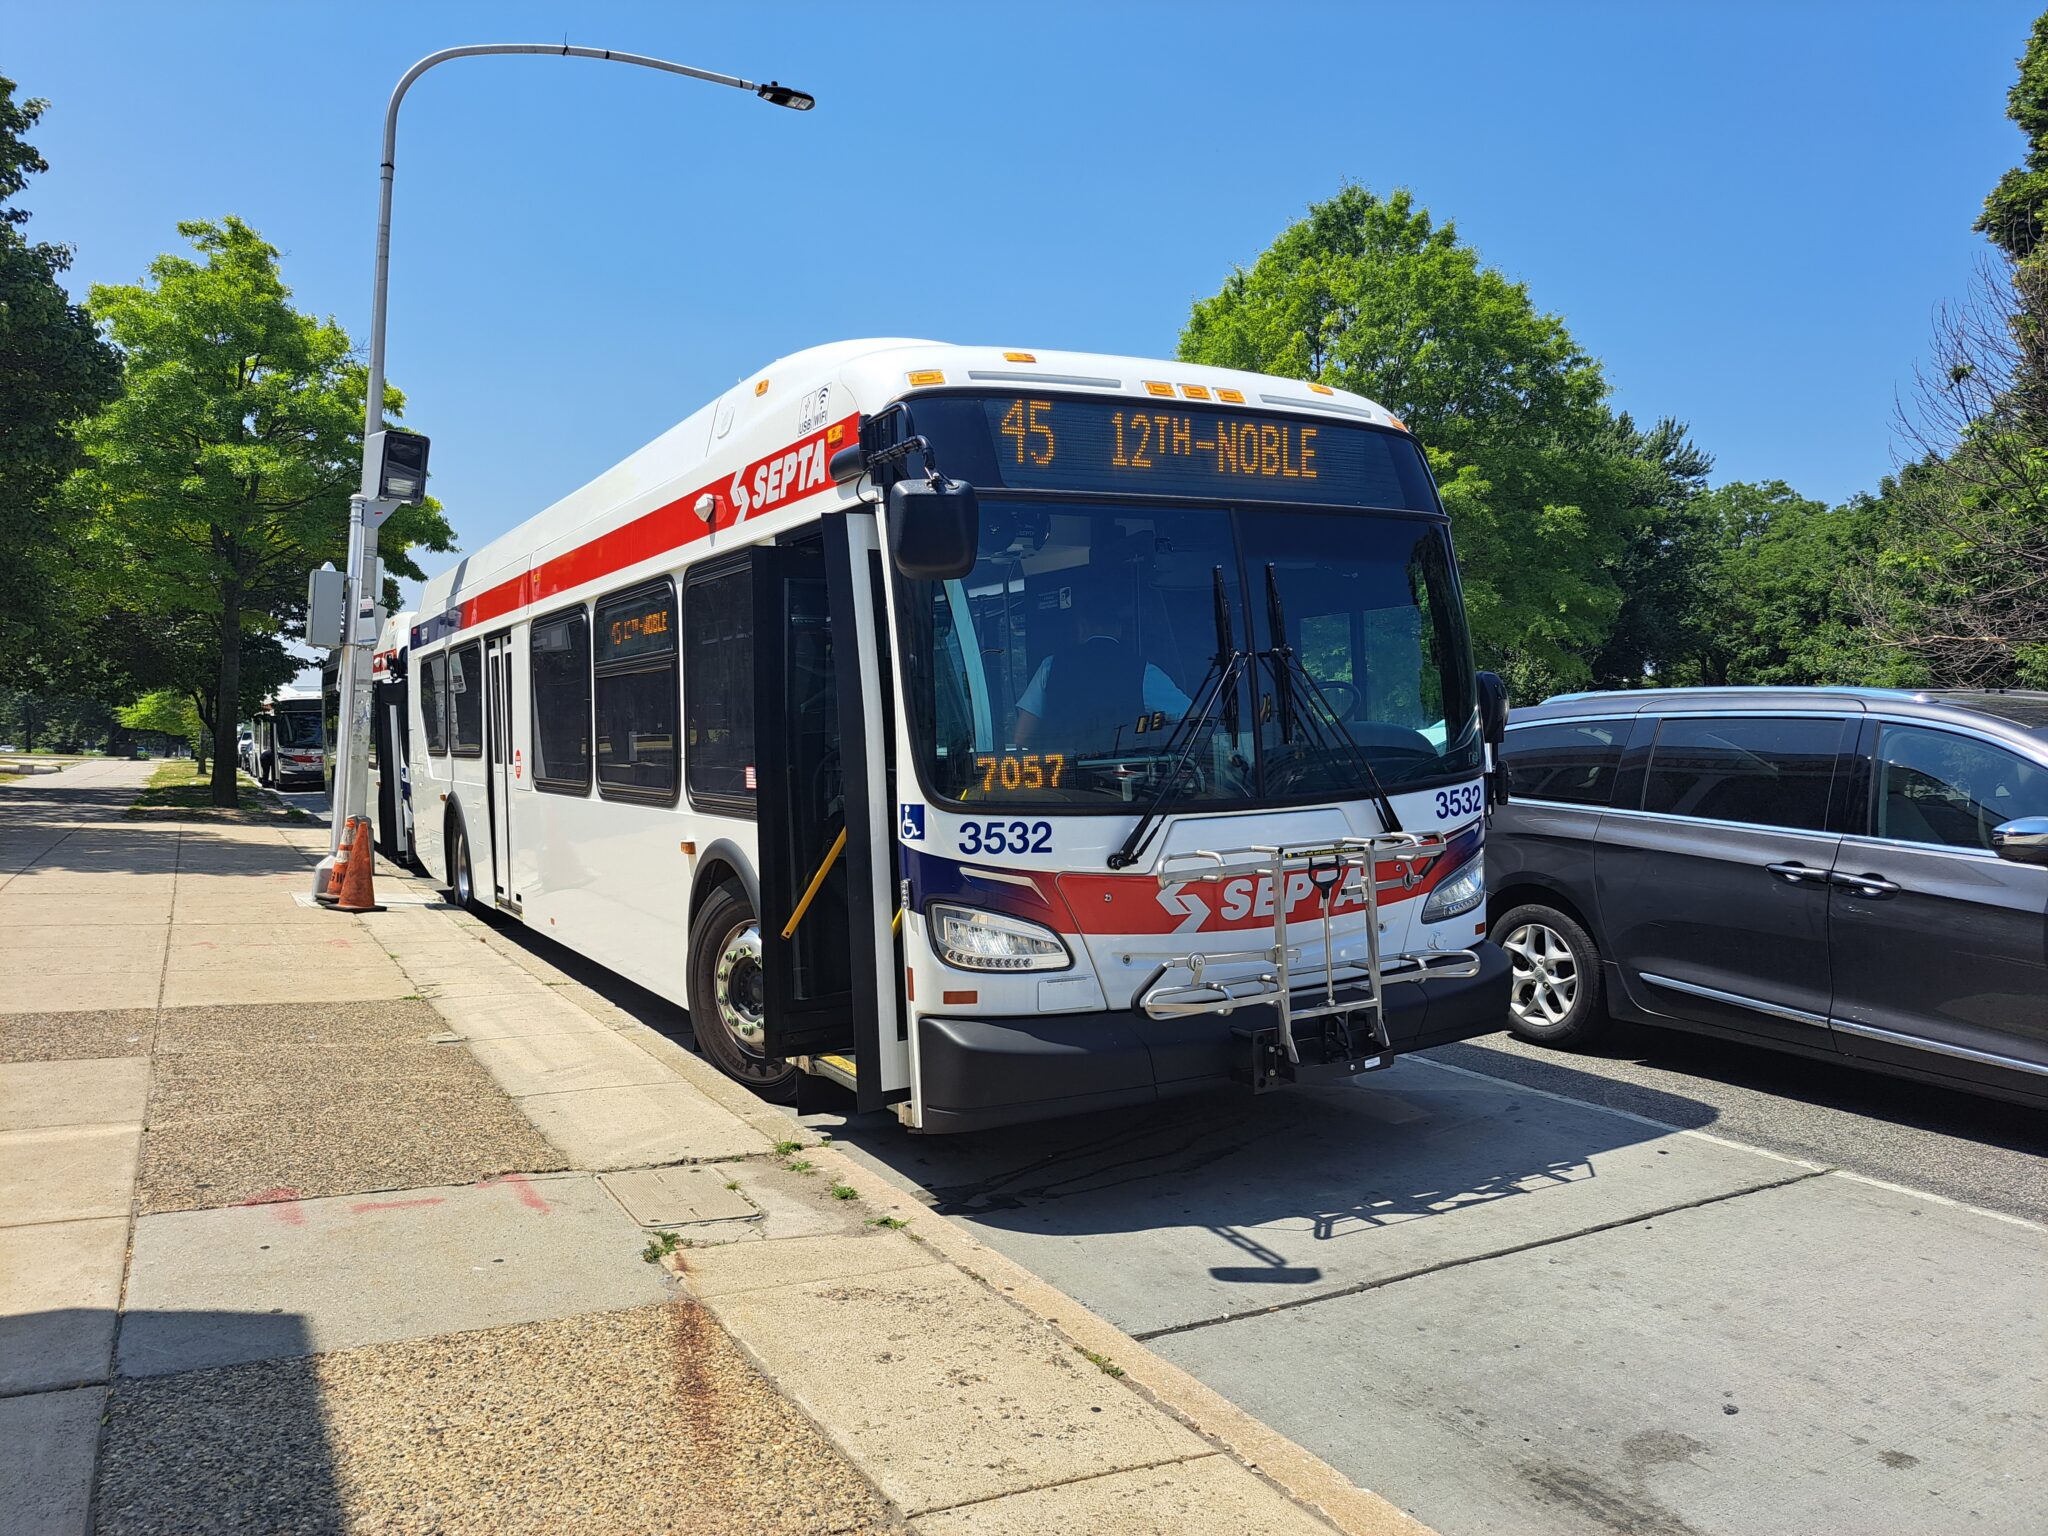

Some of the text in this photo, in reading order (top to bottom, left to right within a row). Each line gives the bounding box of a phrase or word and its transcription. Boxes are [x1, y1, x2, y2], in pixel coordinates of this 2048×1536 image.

[799, 418, 812, 435] USB
[1000, 399, 1318, 478] 45 12TH-NOBLE
[752, 438, 826, 509] SEPTA
[976, 754, 1065, 792] 7057
[1435, 784, 1482, 819] 3532
[958, 821, 1053, 855] 3532
